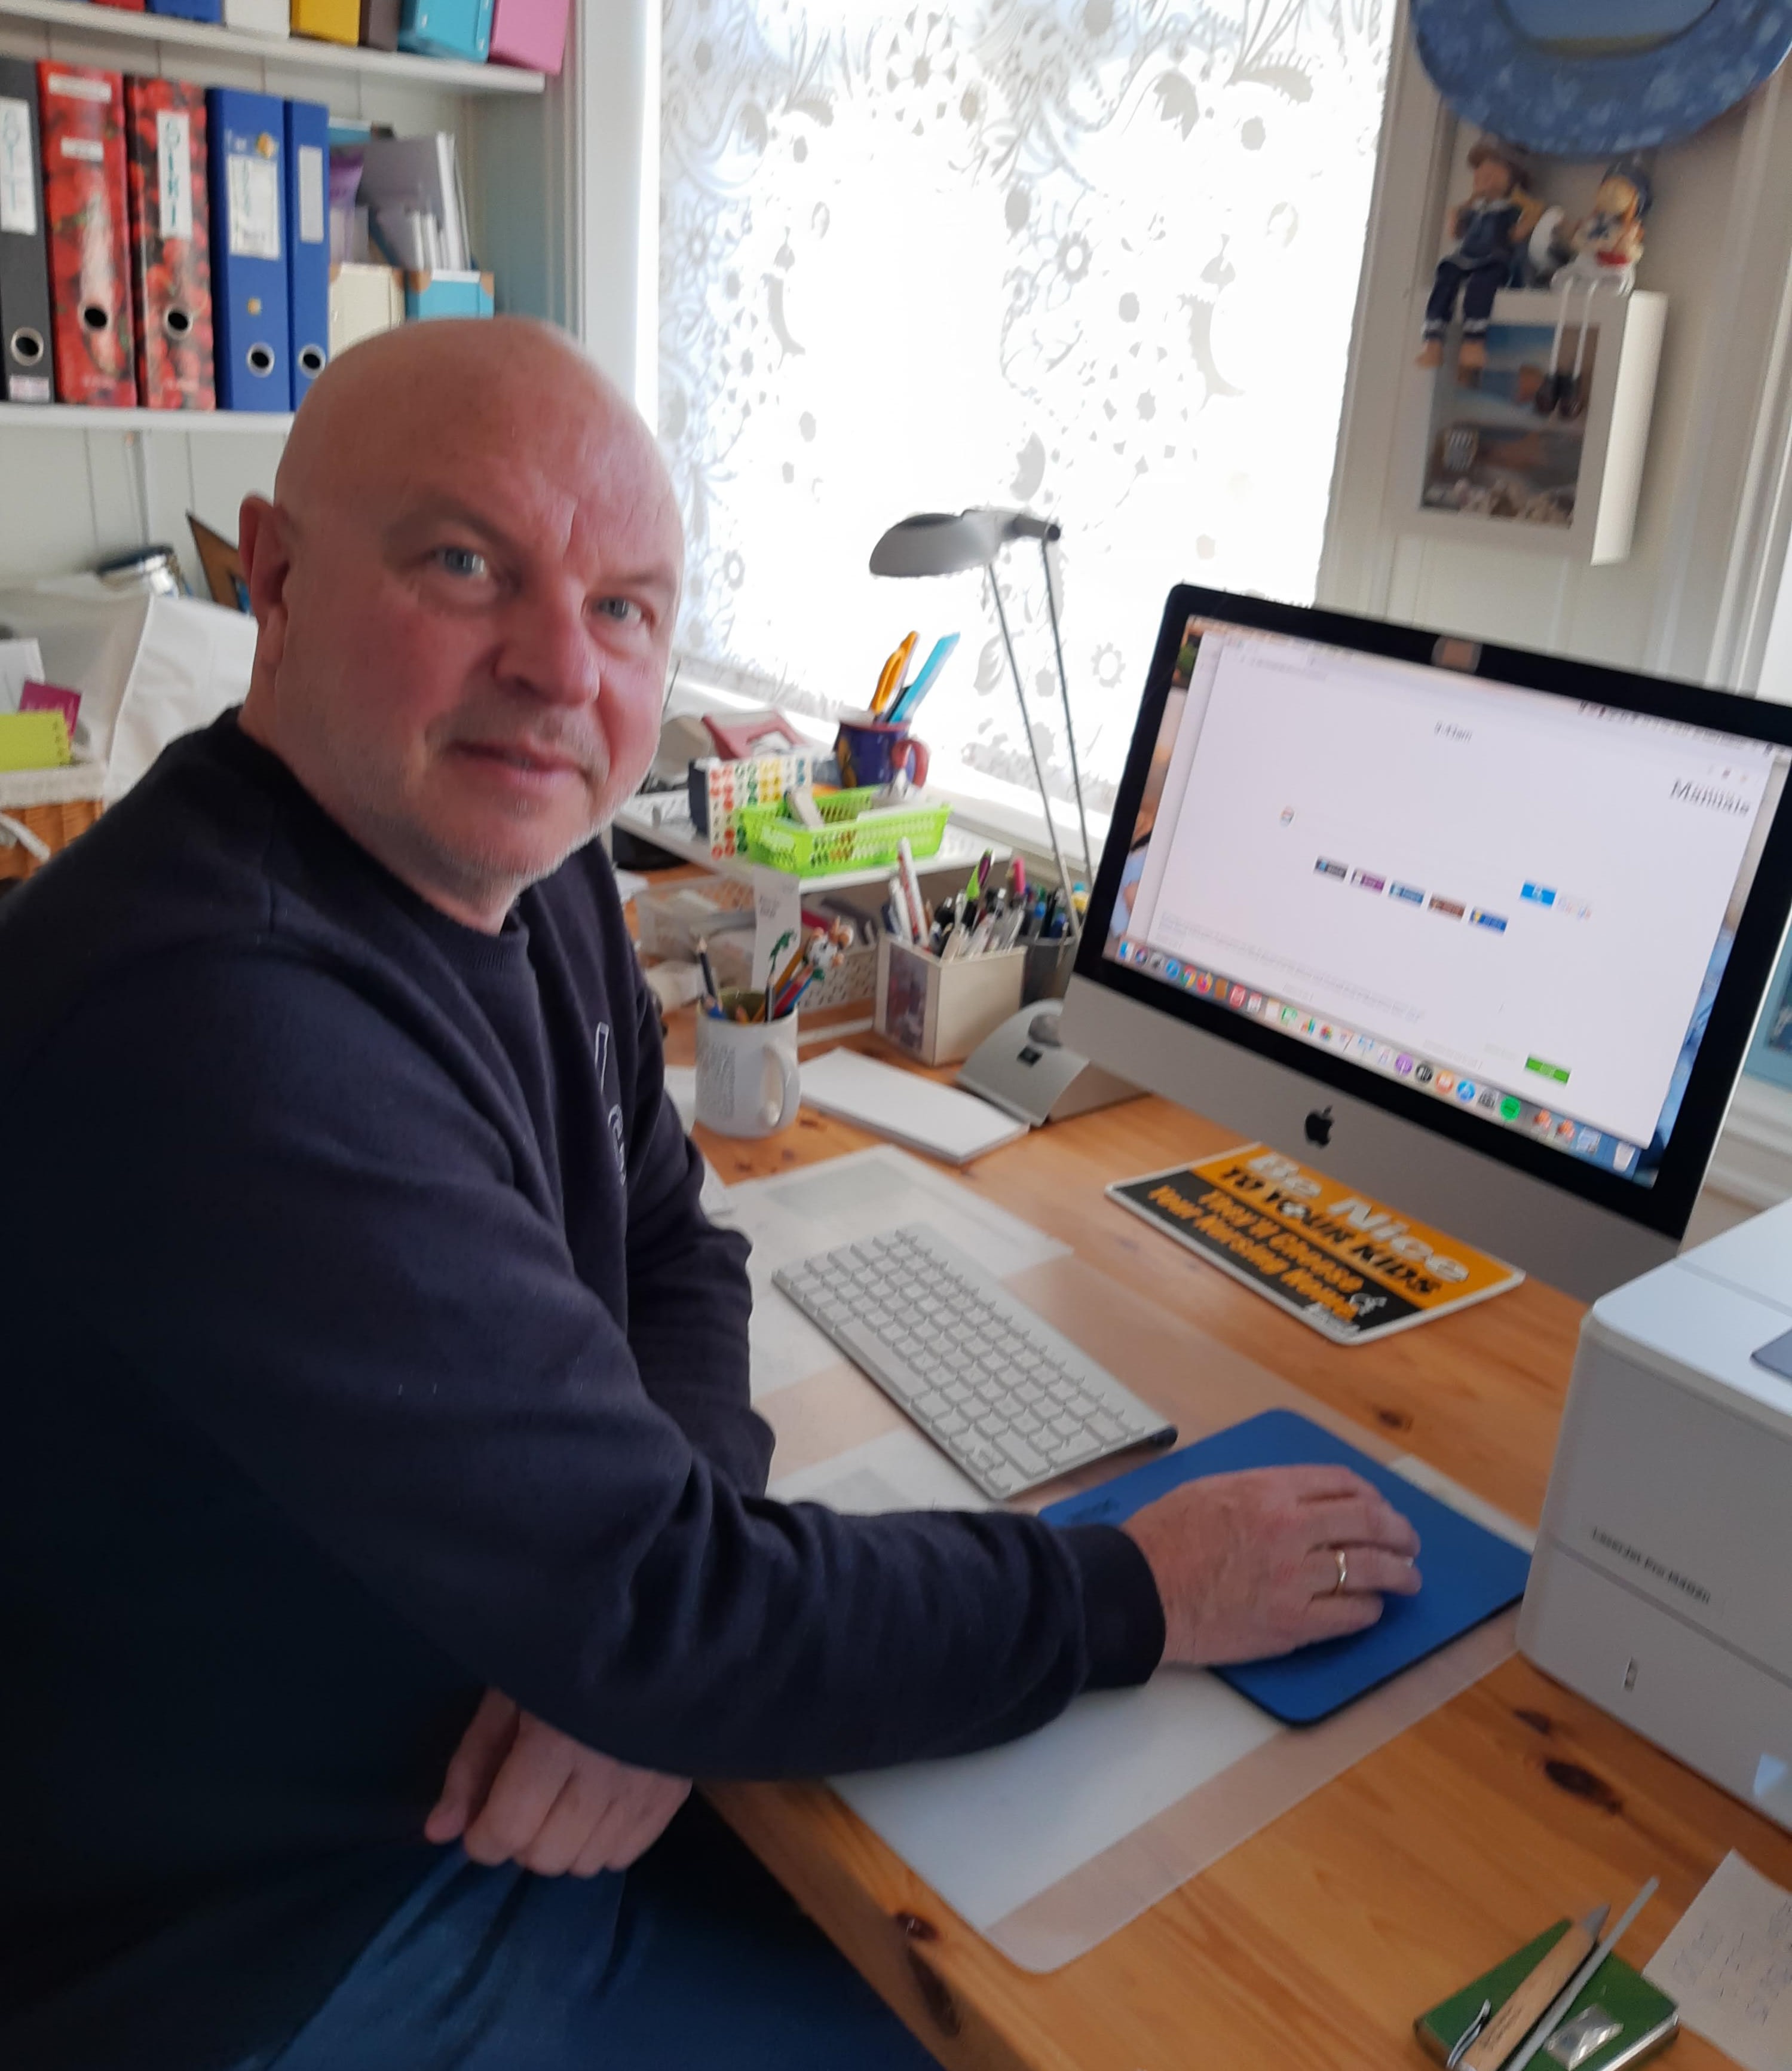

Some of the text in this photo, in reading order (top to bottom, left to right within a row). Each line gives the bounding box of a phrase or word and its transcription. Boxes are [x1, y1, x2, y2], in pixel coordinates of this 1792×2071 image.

[1221, 1165, 1266, 1191] TO
[1352, 1242, 1441, 1295] KIDS
[1248, 1152, 1469, 1283] Be Nice
